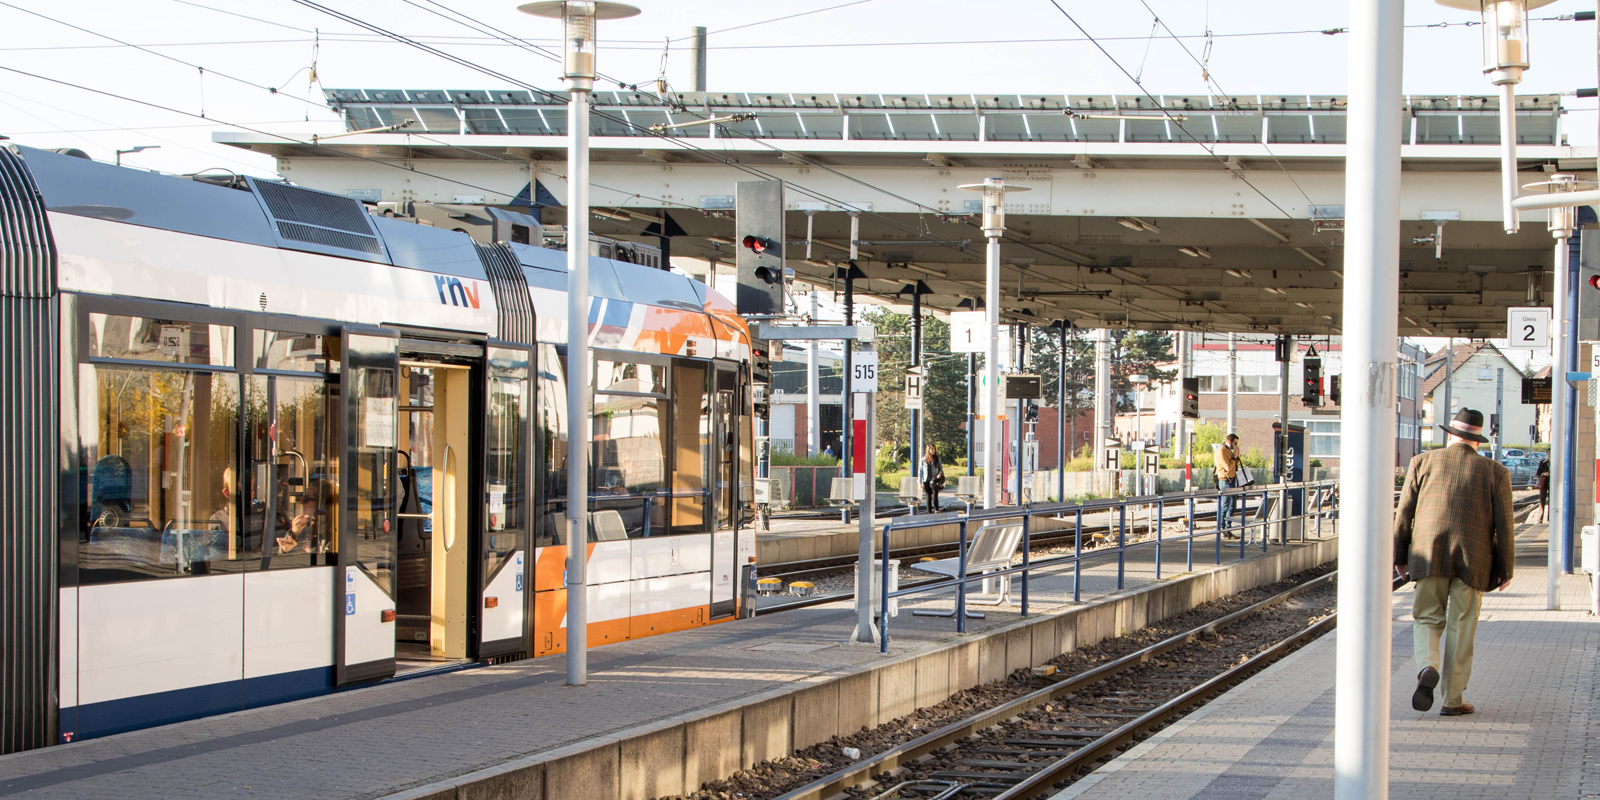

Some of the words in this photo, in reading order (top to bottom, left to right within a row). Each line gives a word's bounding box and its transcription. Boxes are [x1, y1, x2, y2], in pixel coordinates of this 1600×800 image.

[433, 274, 480, 309] rnv
[965, 328, 971, 343] 1
[1523, 325, 1535, 341] 2
[855, 365, 875, 380] 515
[908, 376, 920, 396] H
[1106, 449, 1118, 469] H
[1146, 455, 1158, 474] H
